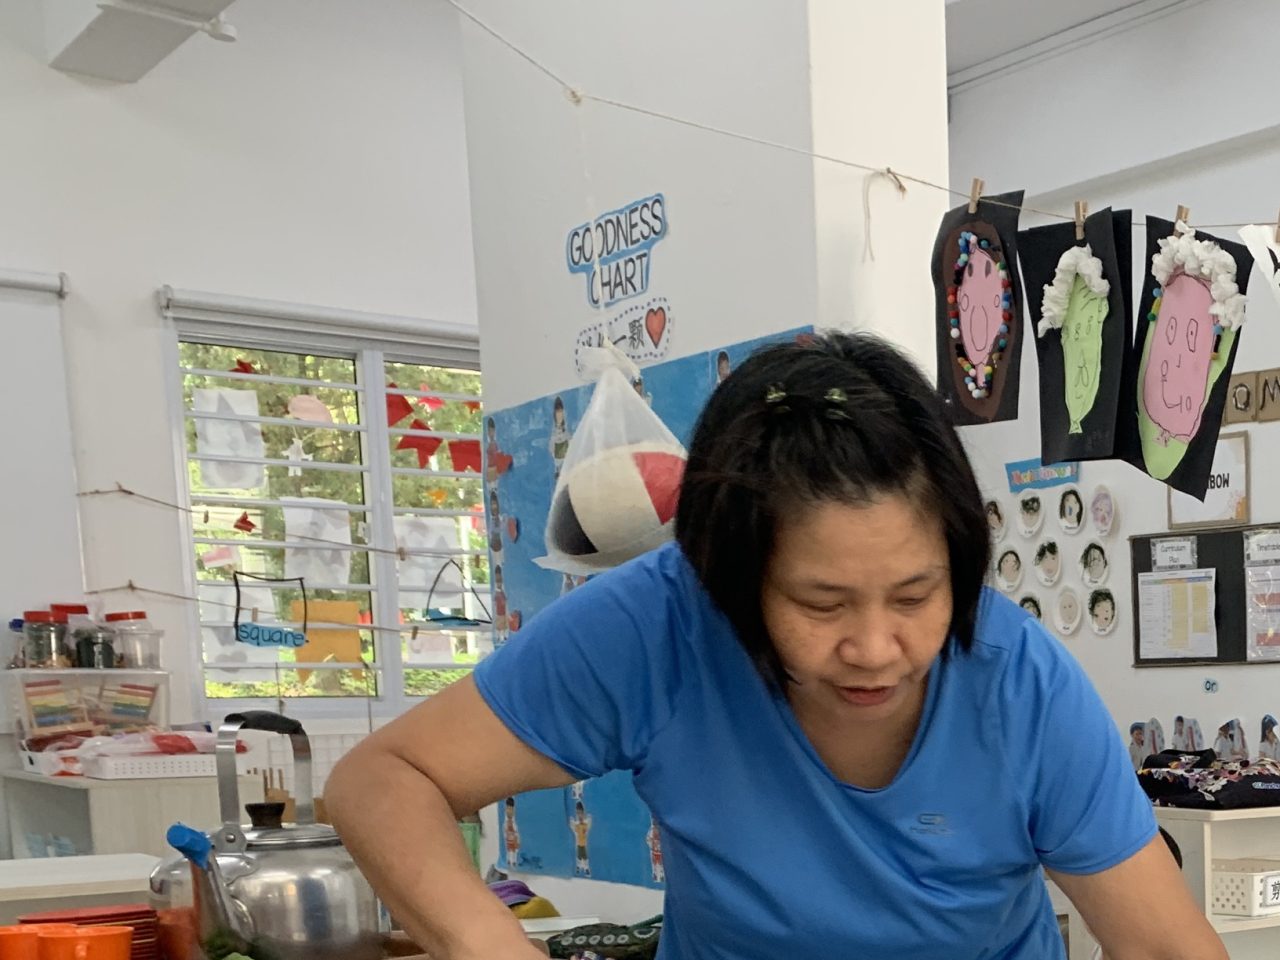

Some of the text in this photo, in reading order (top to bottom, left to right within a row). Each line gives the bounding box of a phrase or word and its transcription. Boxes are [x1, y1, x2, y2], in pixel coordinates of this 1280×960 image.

[570, 198, 663, 266] GOODNESS
[590, 252, 648, 305] CHART
[1207, 473, 1230, 489] BOW
[239, 624, 305, 647] square
